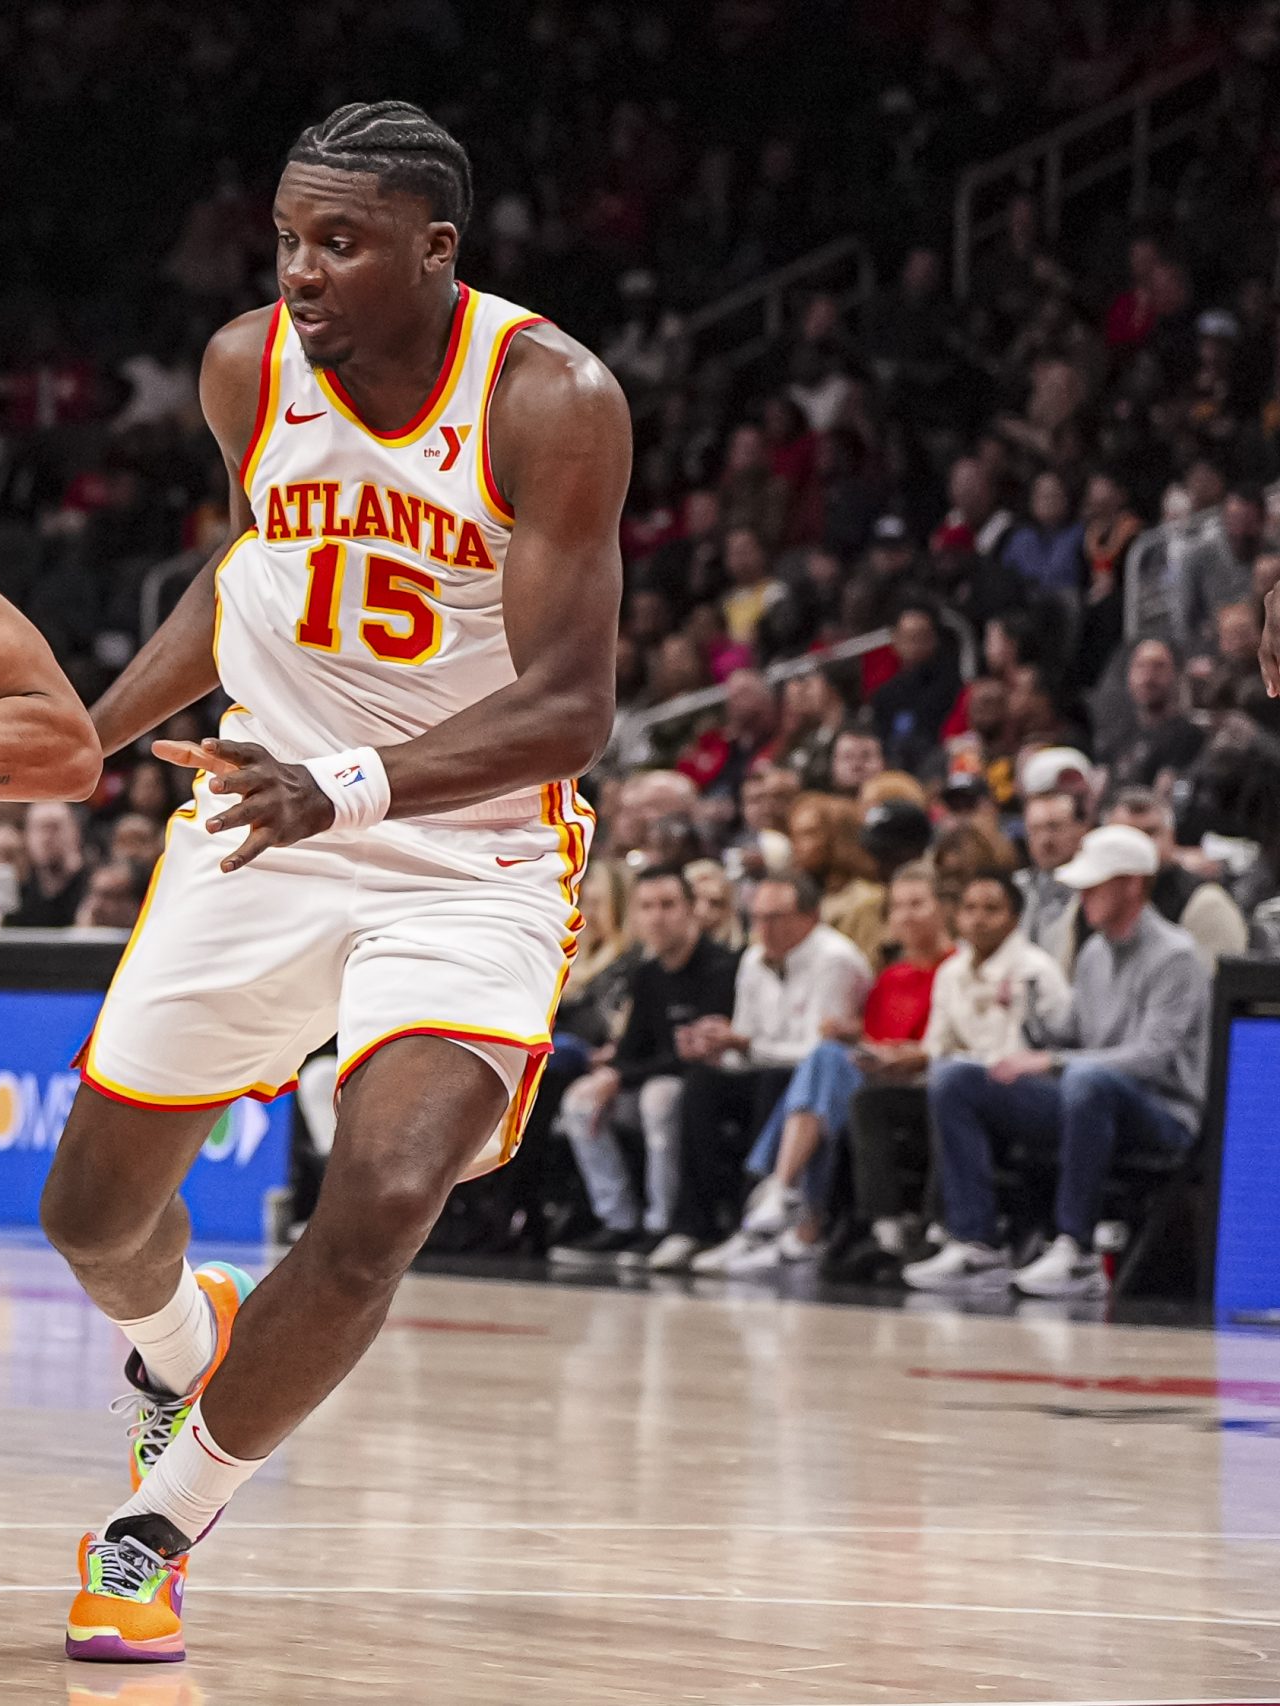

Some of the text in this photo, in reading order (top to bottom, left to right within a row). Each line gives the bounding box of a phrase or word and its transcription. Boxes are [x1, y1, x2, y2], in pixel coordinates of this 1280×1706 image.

[423, 446, 440, 458] the
[265, 480, 498, 572] ATLANTA
[295, 537, 442, 666] 15
